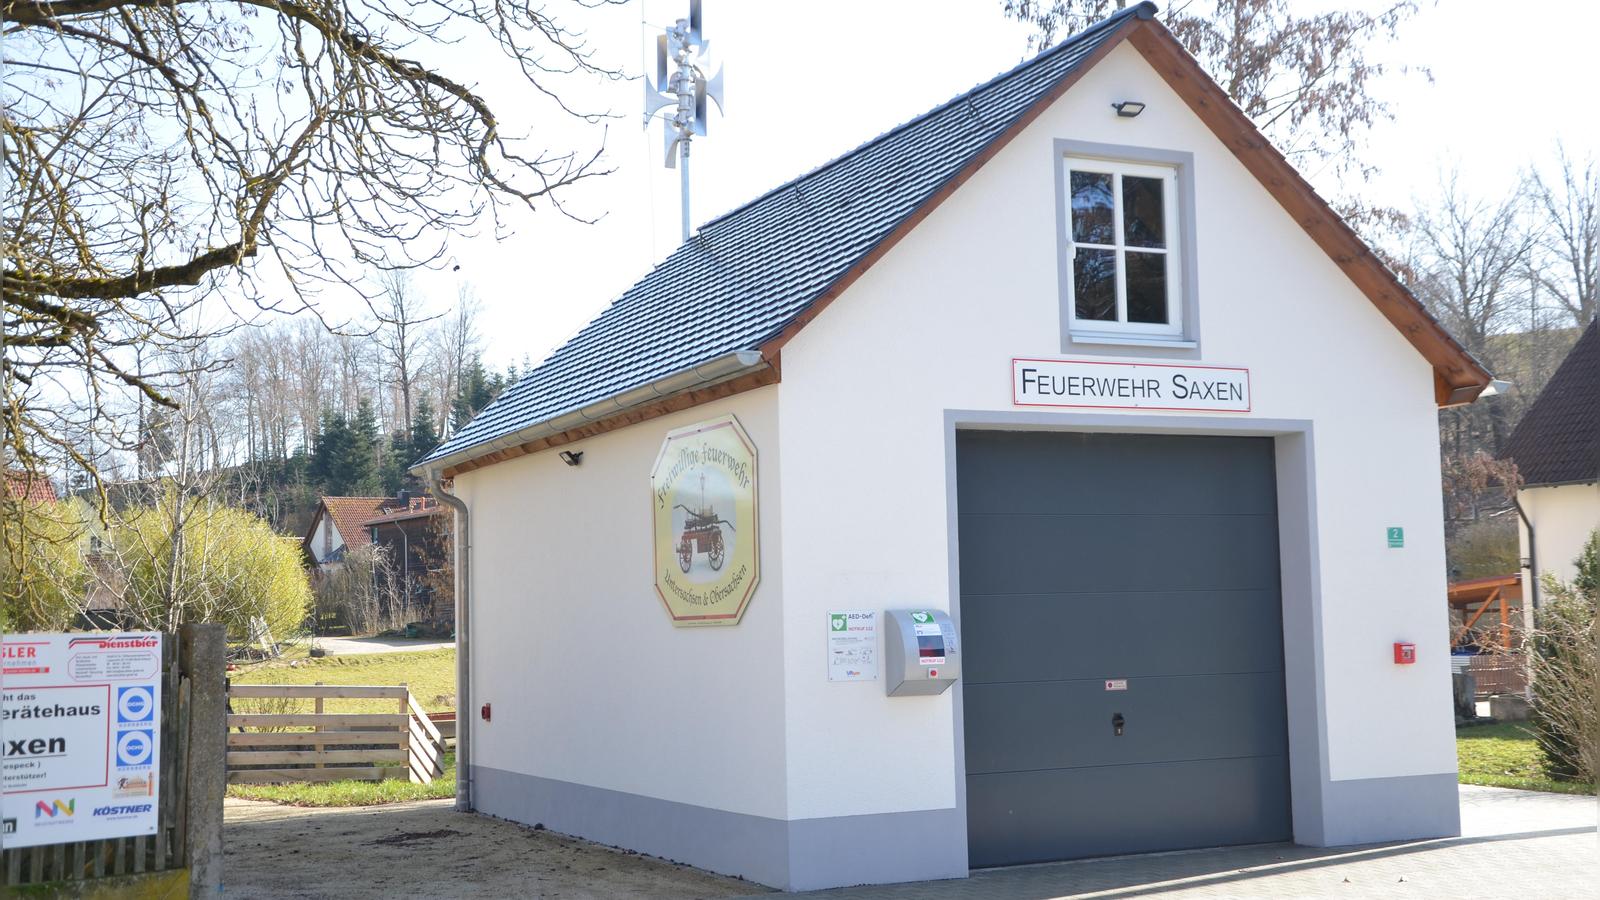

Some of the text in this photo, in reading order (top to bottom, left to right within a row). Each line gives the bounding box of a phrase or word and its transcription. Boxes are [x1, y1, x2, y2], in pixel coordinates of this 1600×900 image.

[1021, 368, 1243, 401] FEUERWEHR SAXEN
[701, 442, 750, 489] Feuerwehr
[1393, 528, 1399, 538] 2
[99, 637, 158, 649] Dienstbier
[17, 693, 36, 701] das
[3, 737, 66, 757] xen
[93, 804, 152, 816] KÖSTNER
